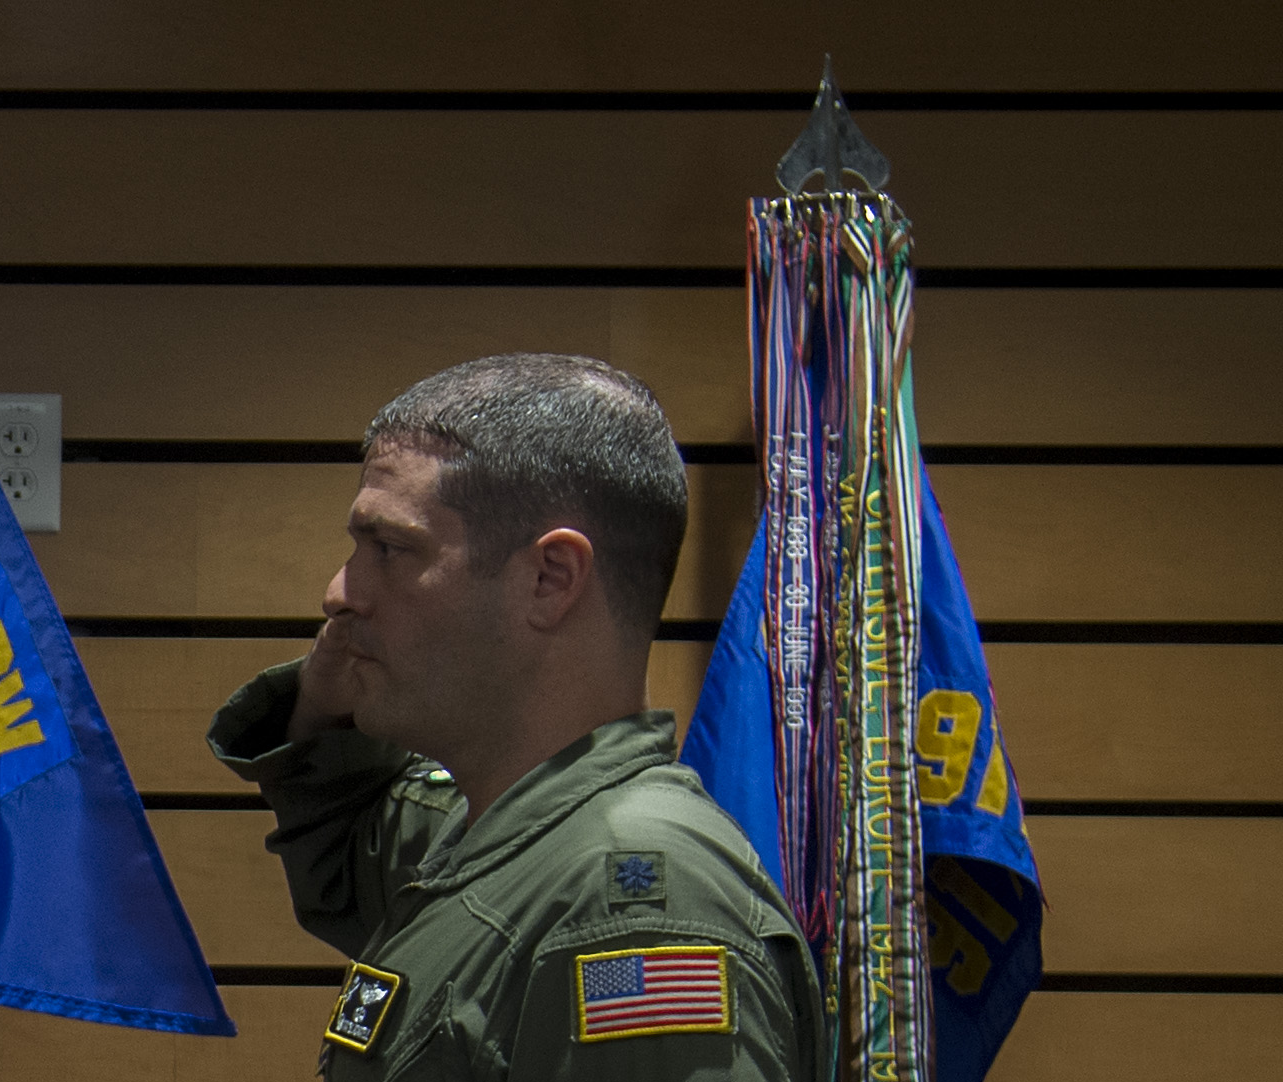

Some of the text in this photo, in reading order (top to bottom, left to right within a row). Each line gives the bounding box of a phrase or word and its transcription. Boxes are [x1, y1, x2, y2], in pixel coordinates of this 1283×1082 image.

[788, 449, 808, 502] JULY
[786, 515, 808, 560] 1988
[786, 583, 809, 609] 30
[785, 619, 809, 674] JUNE
[786, 686, 806, 729] 1990
